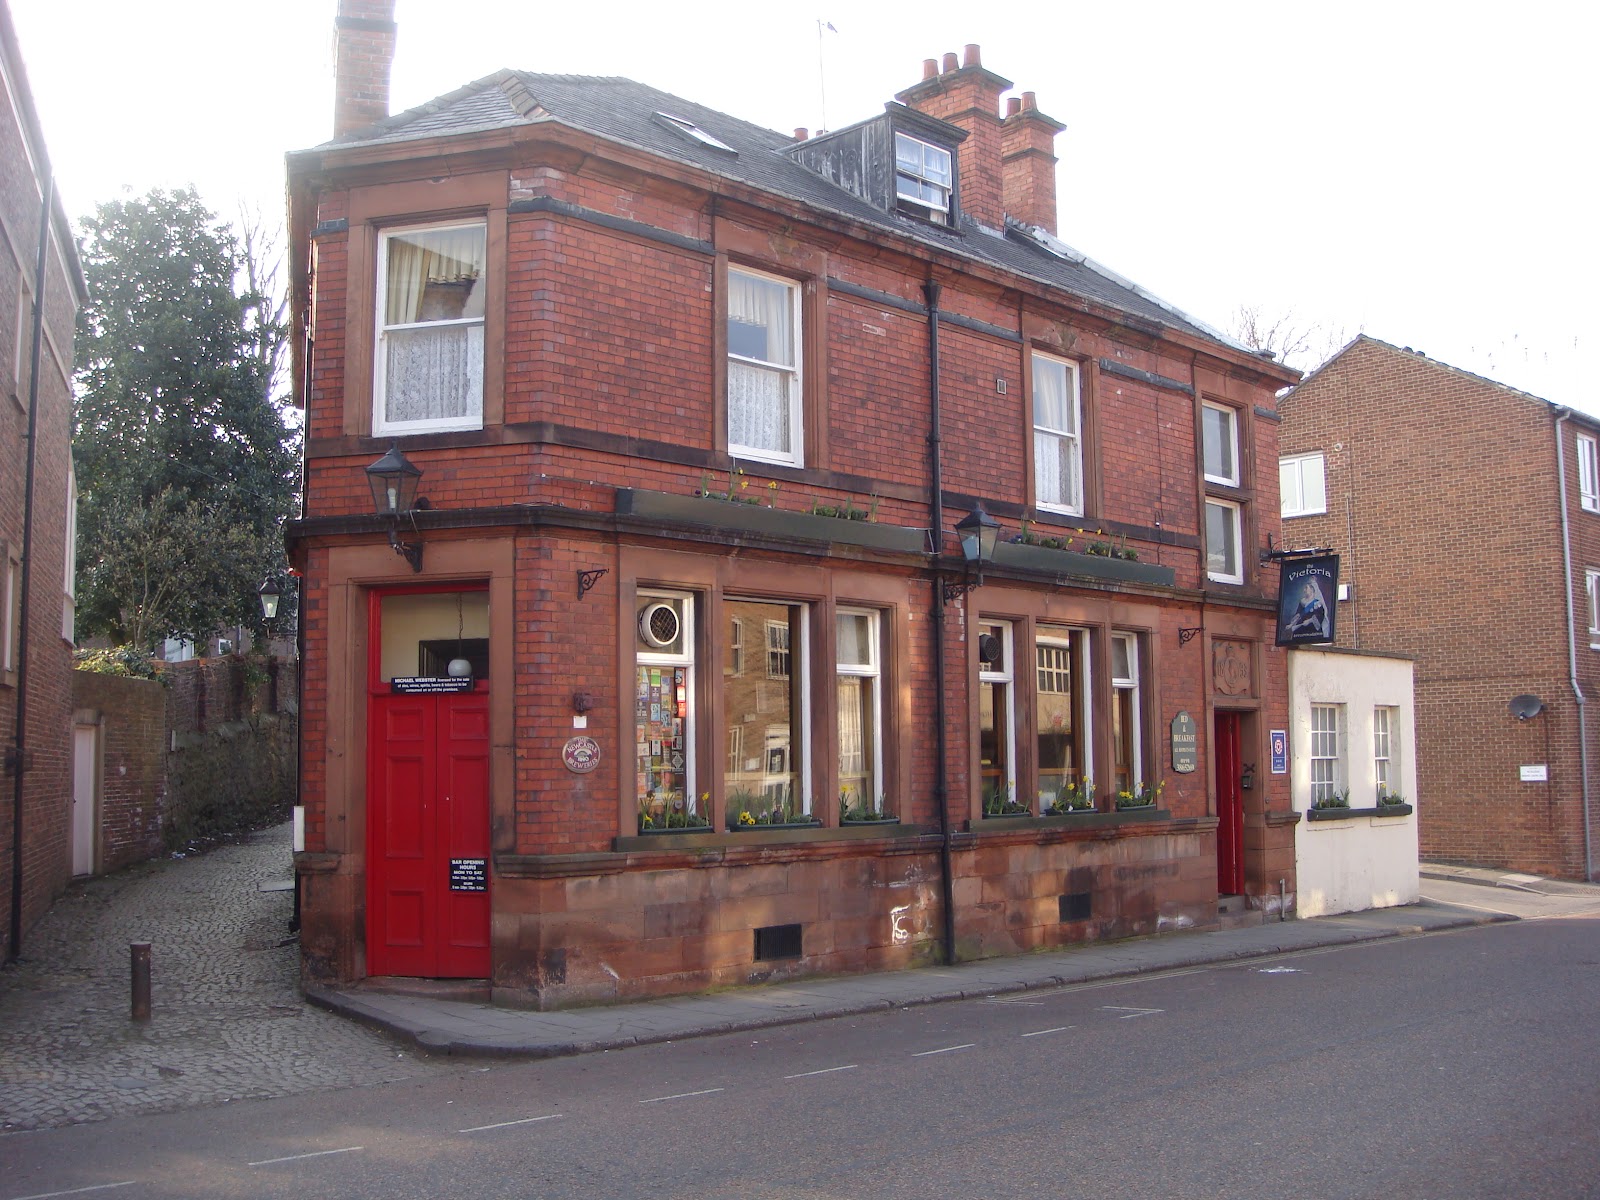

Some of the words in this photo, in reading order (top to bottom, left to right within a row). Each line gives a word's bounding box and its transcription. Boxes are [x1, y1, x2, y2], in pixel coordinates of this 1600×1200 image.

[1288, 568, 1331, 581] Victoria
[1174, 734, 1195, 742] BREAKFAST
[567, 742, 598, 753] NEWCASTLE
[567, 757, 598, 768] BREWERIES
